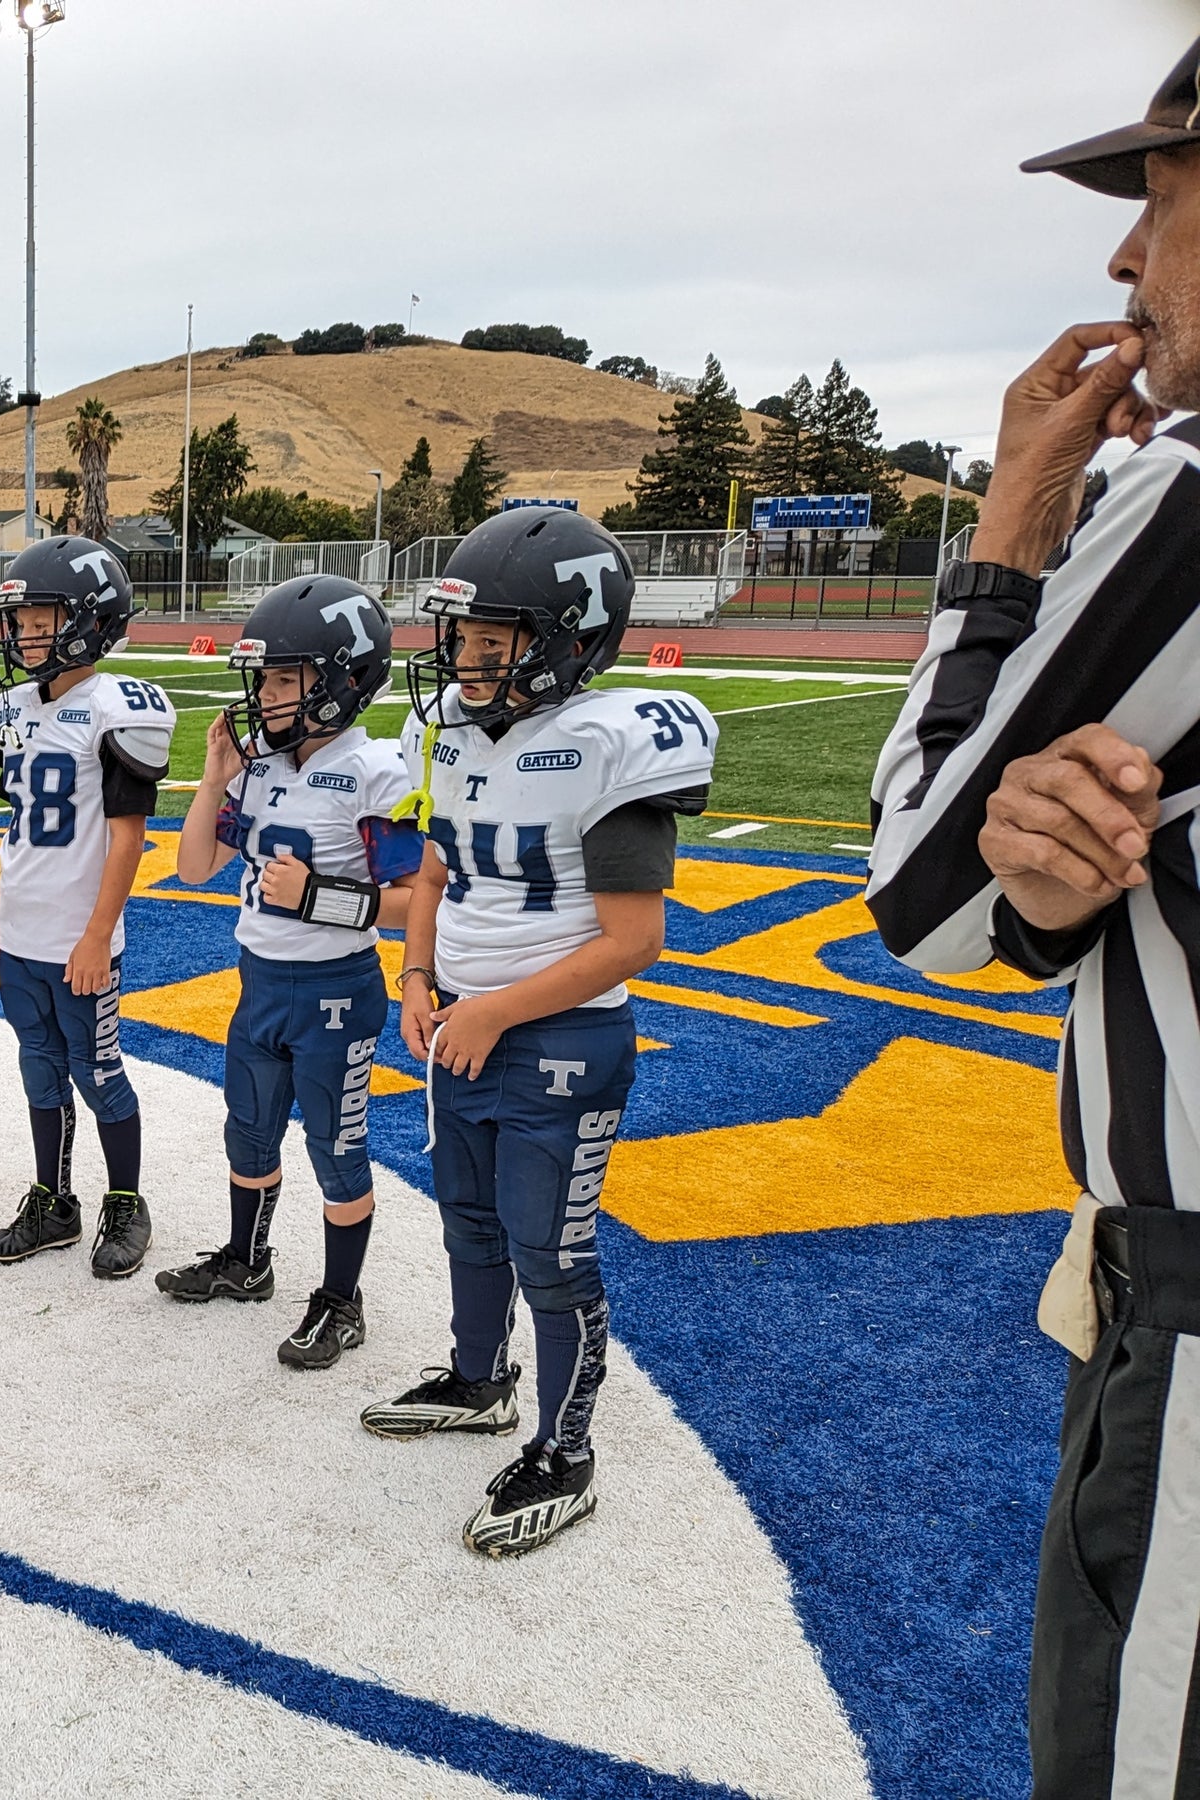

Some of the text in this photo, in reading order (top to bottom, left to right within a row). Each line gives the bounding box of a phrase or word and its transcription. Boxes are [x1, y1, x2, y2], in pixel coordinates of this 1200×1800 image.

[69, 550, 118, 603] T
[554, 551, 618, 630] T
[319, 594, 375, 658] T
[191, 639, 209, 652] 30
[651, 646, 676, 666] 40
[119, 681, 167, 713] 58
[25, 722, 40, 739] T
[634, 699, 709, 752] 34
[523, 753, 575, 769] BATTLE
[268, 786, 287, 807] T
[311, 774, 355, 790] BATTLE
[466, 774, 487, 801] T
[319, 997, 352, 1029] T
[538, 1058, 585, 1097] T
